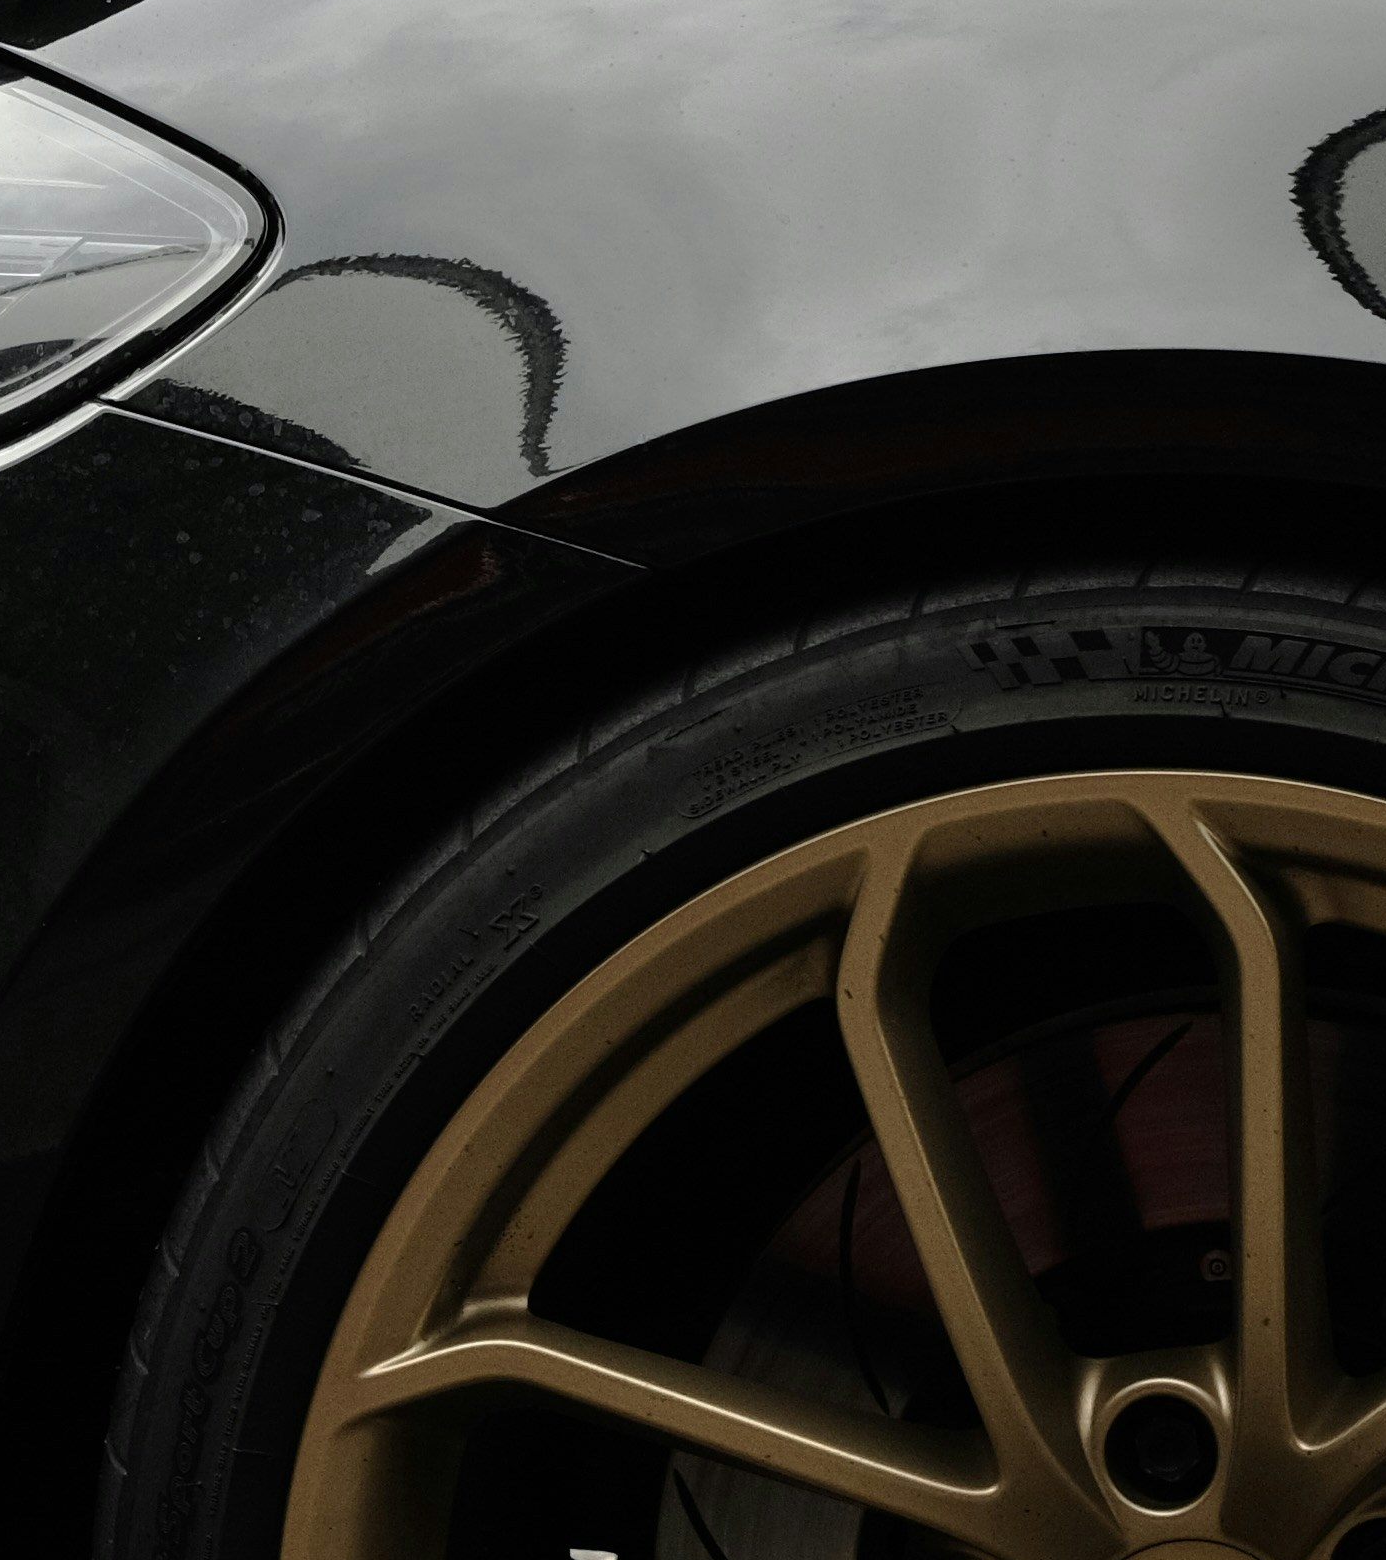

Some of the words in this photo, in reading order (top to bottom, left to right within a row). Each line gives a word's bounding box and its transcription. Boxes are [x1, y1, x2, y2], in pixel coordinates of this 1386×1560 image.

[401, 945, 477, 1027] RADIAL
[216, 1224, 270, 1284] 2
[183, 1277, 250, 1385] Cup
[149, 1385, 218, 1546] Sport
